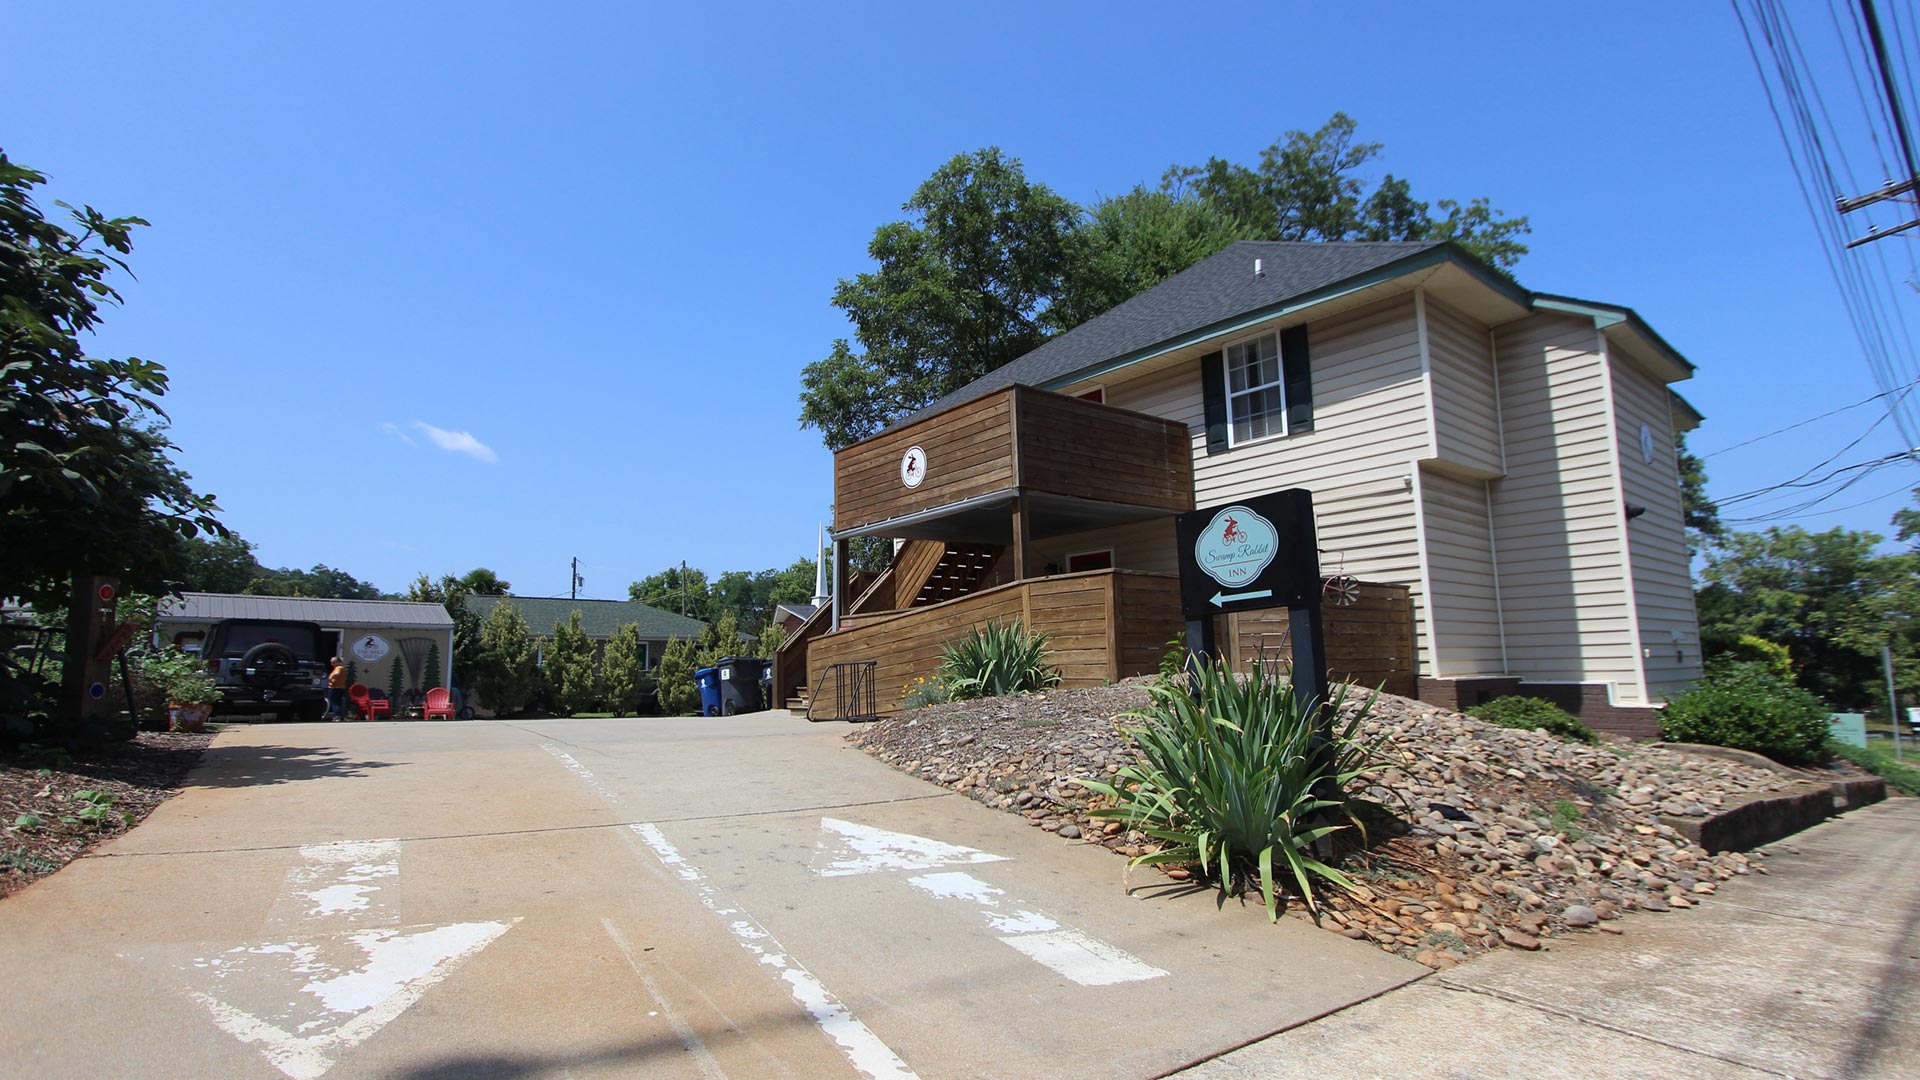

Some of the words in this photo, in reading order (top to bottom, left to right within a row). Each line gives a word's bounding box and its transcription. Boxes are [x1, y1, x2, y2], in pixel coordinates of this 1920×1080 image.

[1205, 549, 1236, 564] Swamp
[1237, 543, 1269, 557] Rabbit
[1228, 567, 1247, 578] INN
